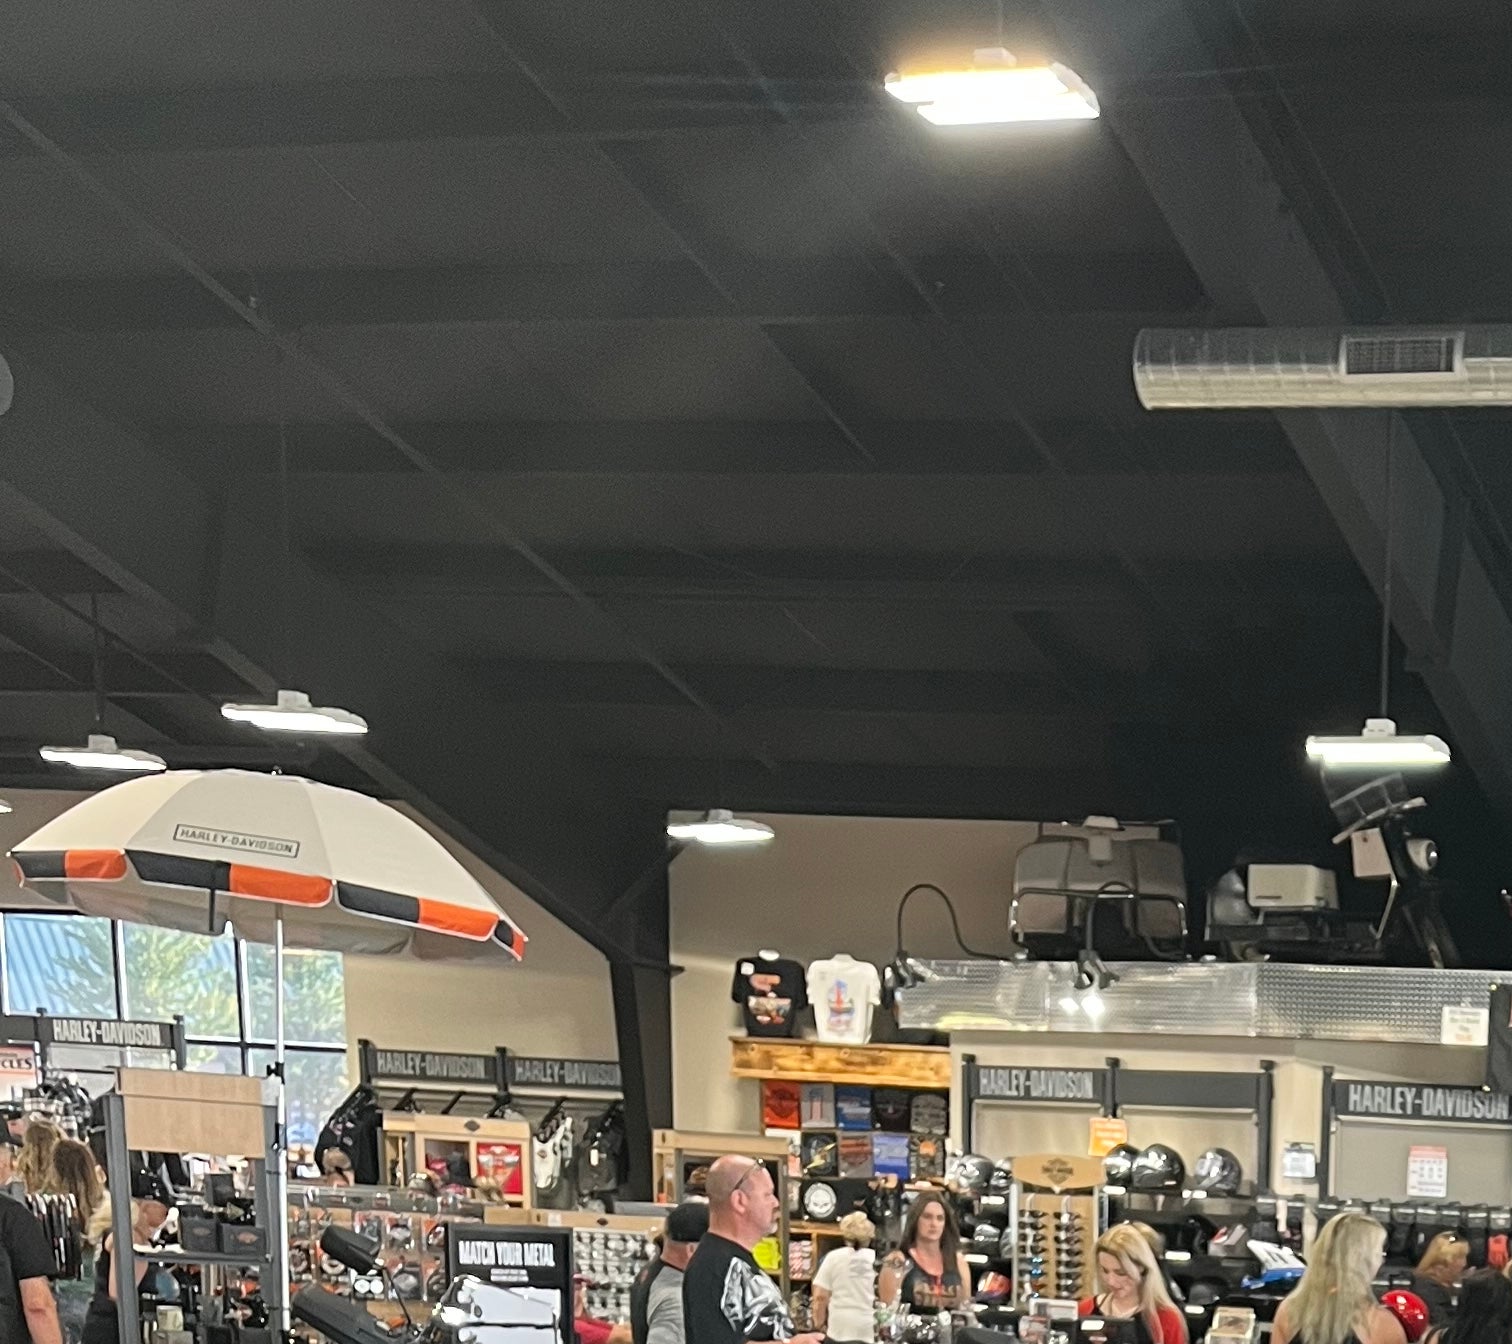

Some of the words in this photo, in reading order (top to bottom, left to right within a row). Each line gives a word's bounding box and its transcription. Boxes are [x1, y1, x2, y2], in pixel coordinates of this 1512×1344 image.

[180, 829, 294, 853] HARLEY-DAVIDSON
[53, 1019, 161, 1046] HARLEY-DAVIDSON
[377, 1052, 486, 1078] HARLEY-DAVIDSON
[980, 1069, 1093, 1098] HARLEY-DAVIDSON
[1348, 1084, 1510, 1120] HARLEY-DAVIDSON
[458, 1240, 495, 1265] MATCH
[496, 1241, 523, 1266] YOUR
[523, 1242, 556, 1267] METAL
